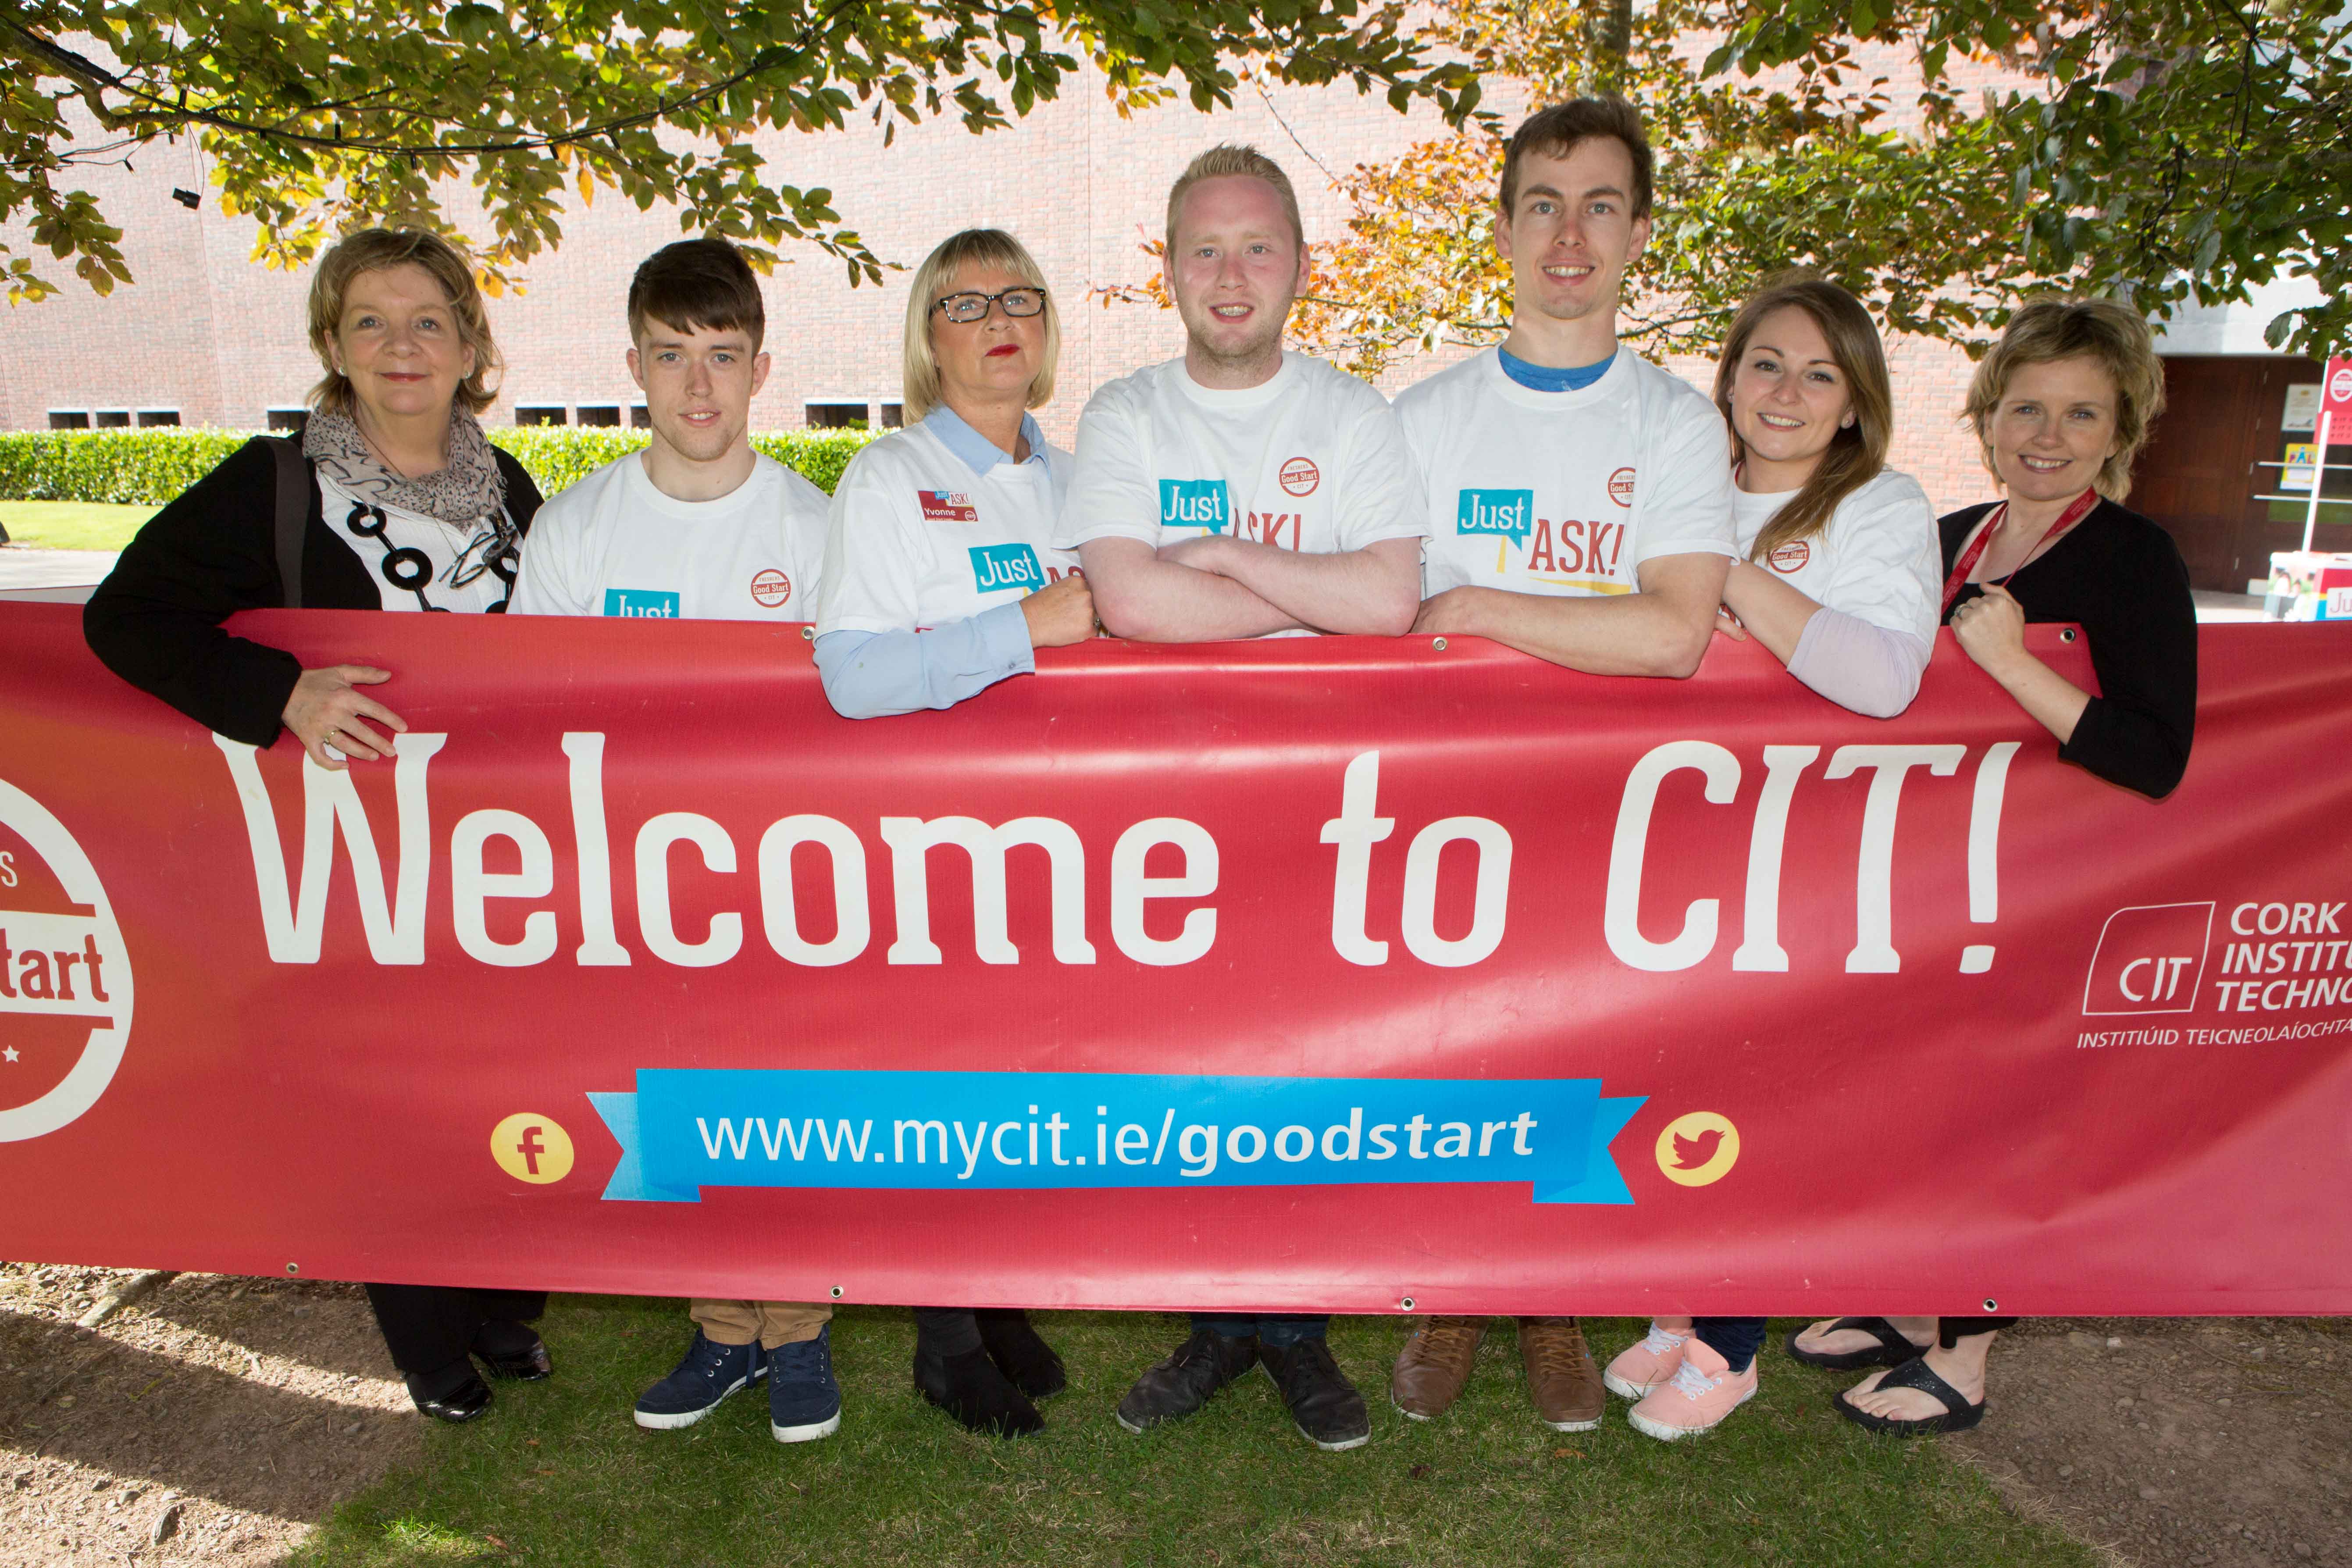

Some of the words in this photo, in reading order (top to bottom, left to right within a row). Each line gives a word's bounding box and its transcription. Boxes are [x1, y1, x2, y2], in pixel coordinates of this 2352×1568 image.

[1281, 474, 1298, 483] Good
[1300, 470, 1317, 481] Start
[1611, 483, 1626, 492] Good
[951, 493, 969, 505] ASK!
[1164, 485, 1222, 521] Just
[1461, 494, 1524, 530] Just
[1528, 519, 1625, 576] ASK!
[980, 550, 1038, 586] Just
[753, 584, 770, 594] Good
[772, 583, 789, 592] Start
[212, 731, 1219, 967] Welcome
[1320, 750, 1513, 967] to
[1604, 740, 2022, 973] CIT!
[2230, 902, 2347, 936] CORK
[2119, 957, 2193, 1002] CIT
[2077, 1026, 2179, 1049] INSTITIÚID
[696, 1104, 1538, 1180] www.mycit.ie/goodstart
